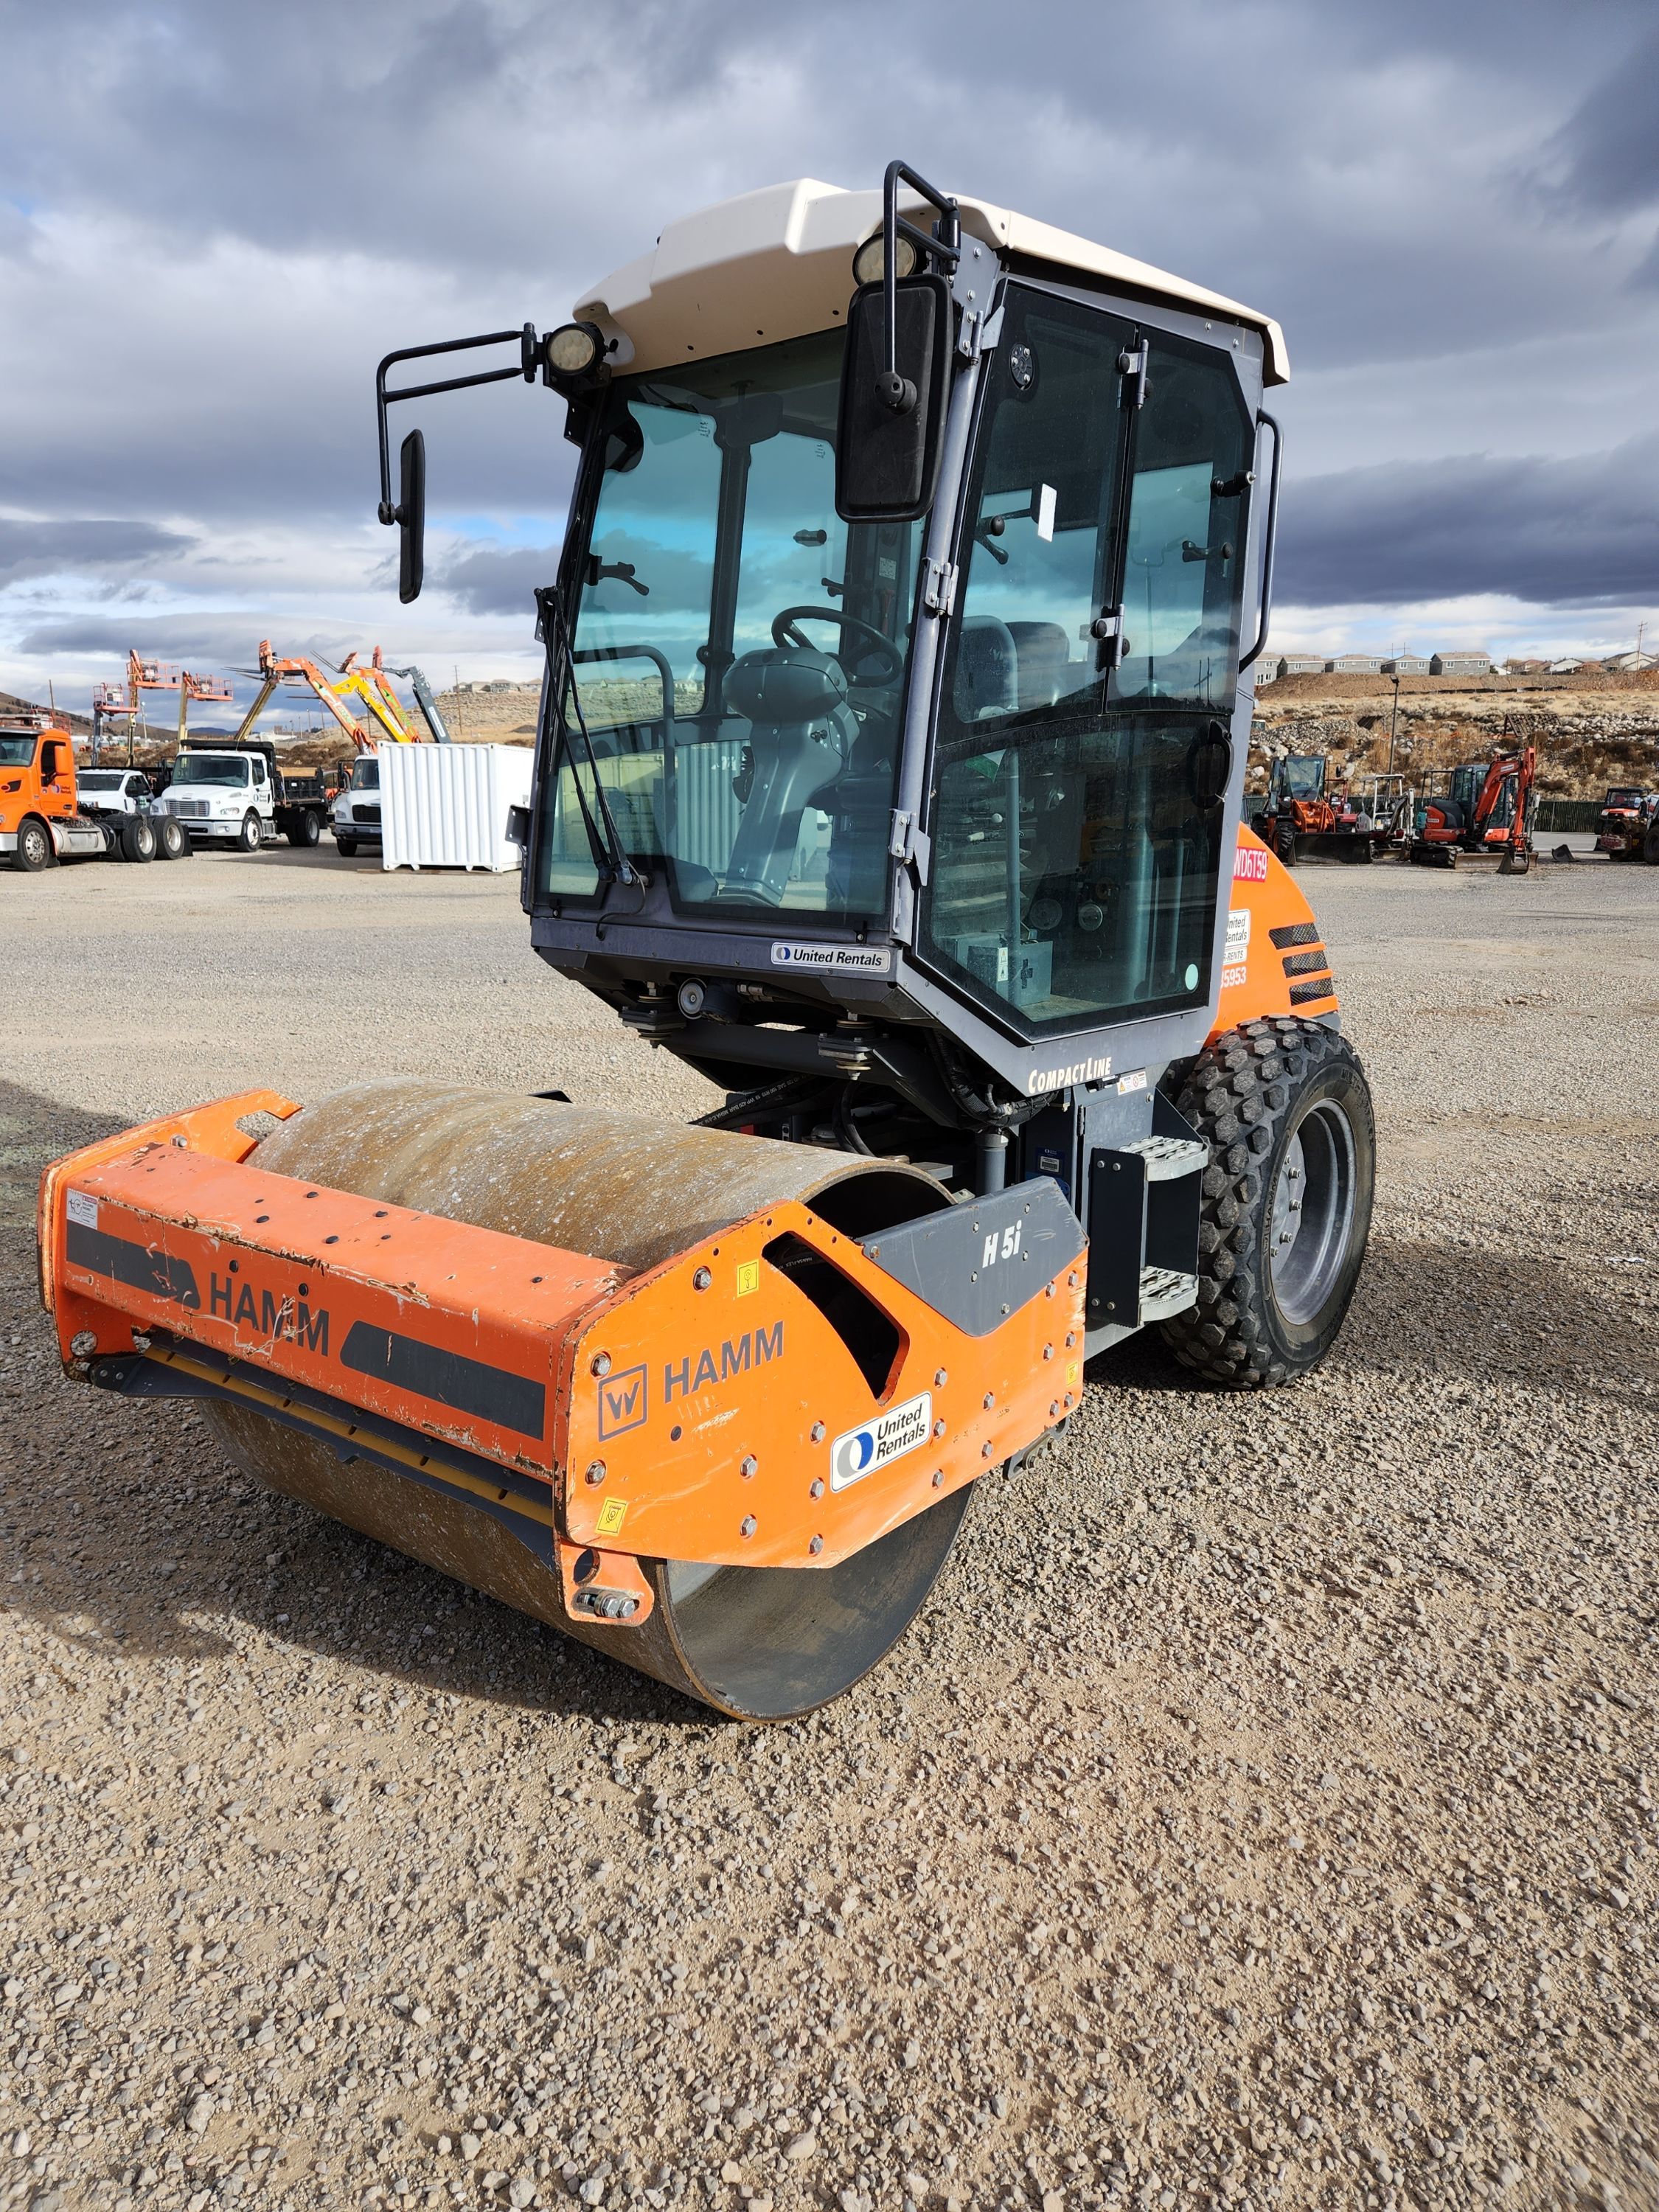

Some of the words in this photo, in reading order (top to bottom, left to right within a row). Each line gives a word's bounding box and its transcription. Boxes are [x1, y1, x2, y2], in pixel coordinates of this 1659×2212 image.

[793, 948, 834, 963] United
[836, 951, 883, 966] Rentals
[982, 1232, 999, 1268] H
[1001, 1220, 1022, 1259] 5i
[211, 1271, 330, 1357] HAMM
[664, 1320, 784, 1404] HAMM
[876, 1423, 926, 1461] Rentals
[877, 1402, 923, 1441] United
